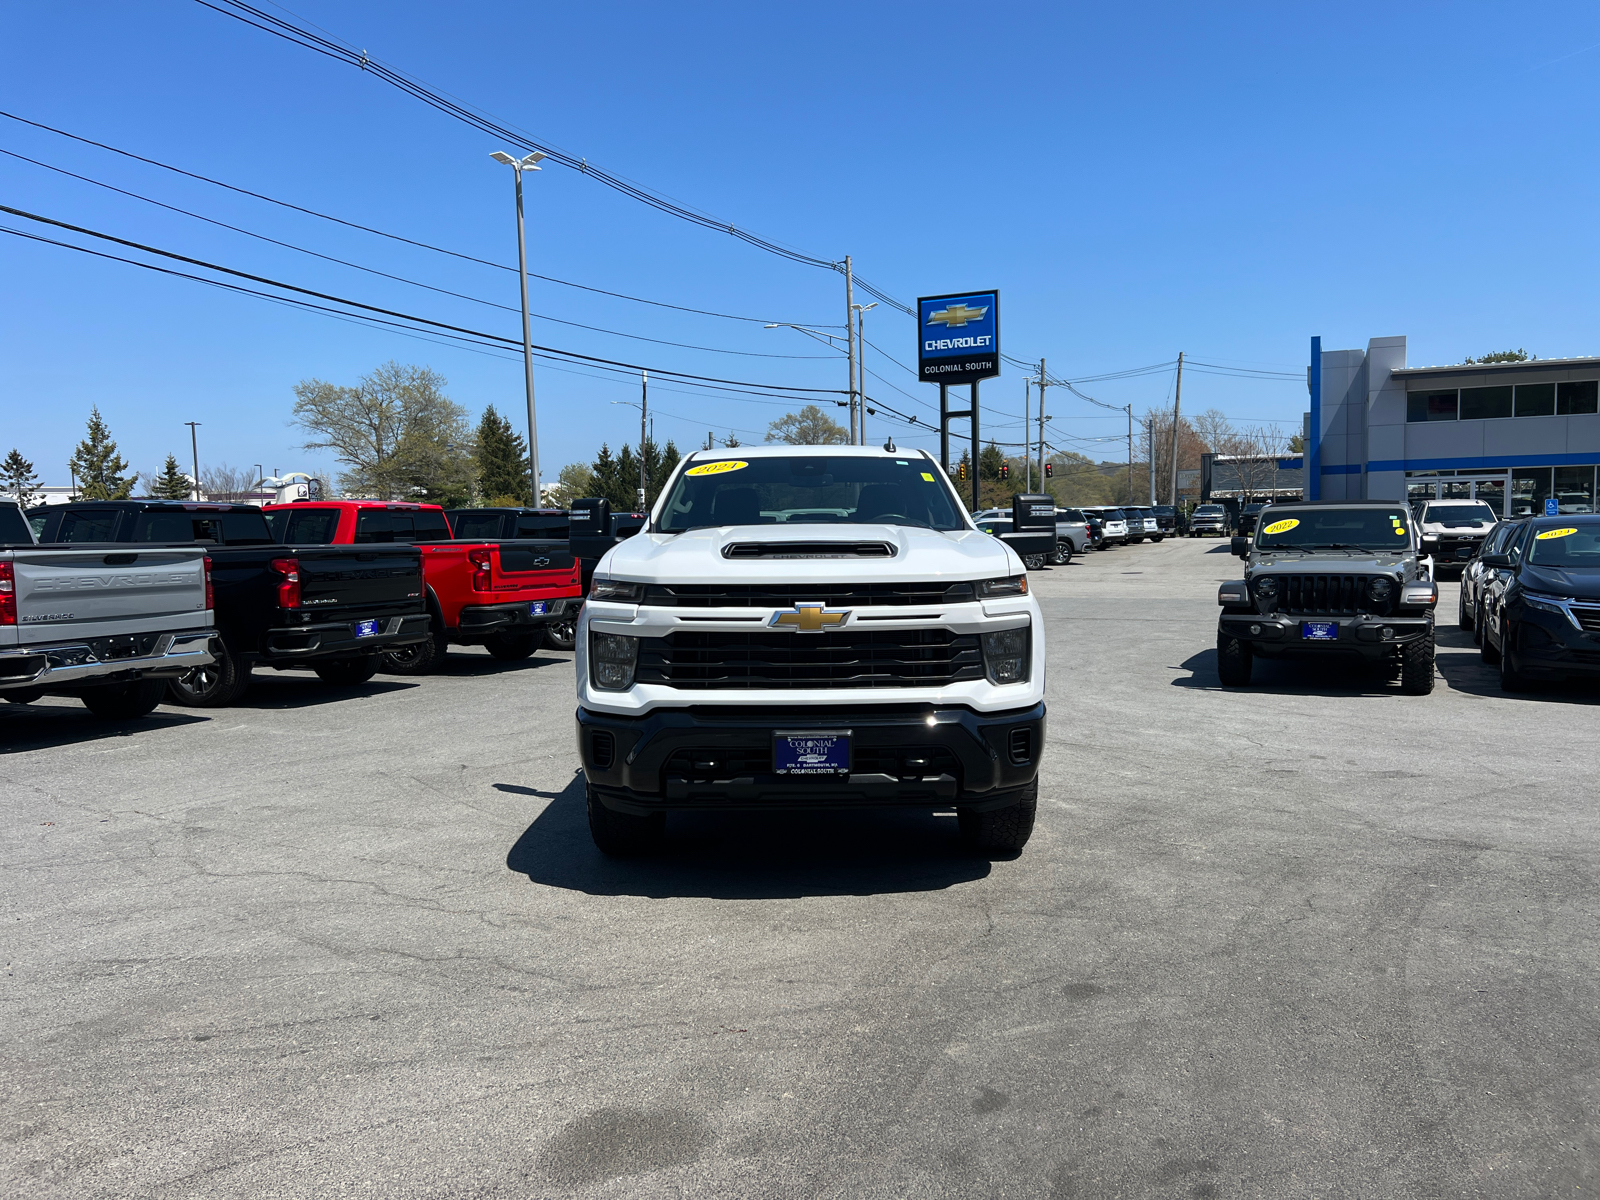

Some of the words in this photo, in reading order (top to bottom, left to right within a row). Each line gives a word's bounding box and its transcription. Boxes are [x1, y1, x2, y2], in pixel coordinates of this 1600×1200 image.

[925, 335, 991, 350] CHEVROLET
[924, 364, 963, 374] COLONIAL
[965, 361, 992, 371] SOUTH
[694, 462, 737, 474] 2024
[1270, 521, 1293, 532] 2022
[33, 572, 197, 591] CHEVROLET
[22, 614, 74, 622] SILVERADO
[789, 740, 835, 748] COLONIAL
[796, 747, 828, 755] SOUTH
